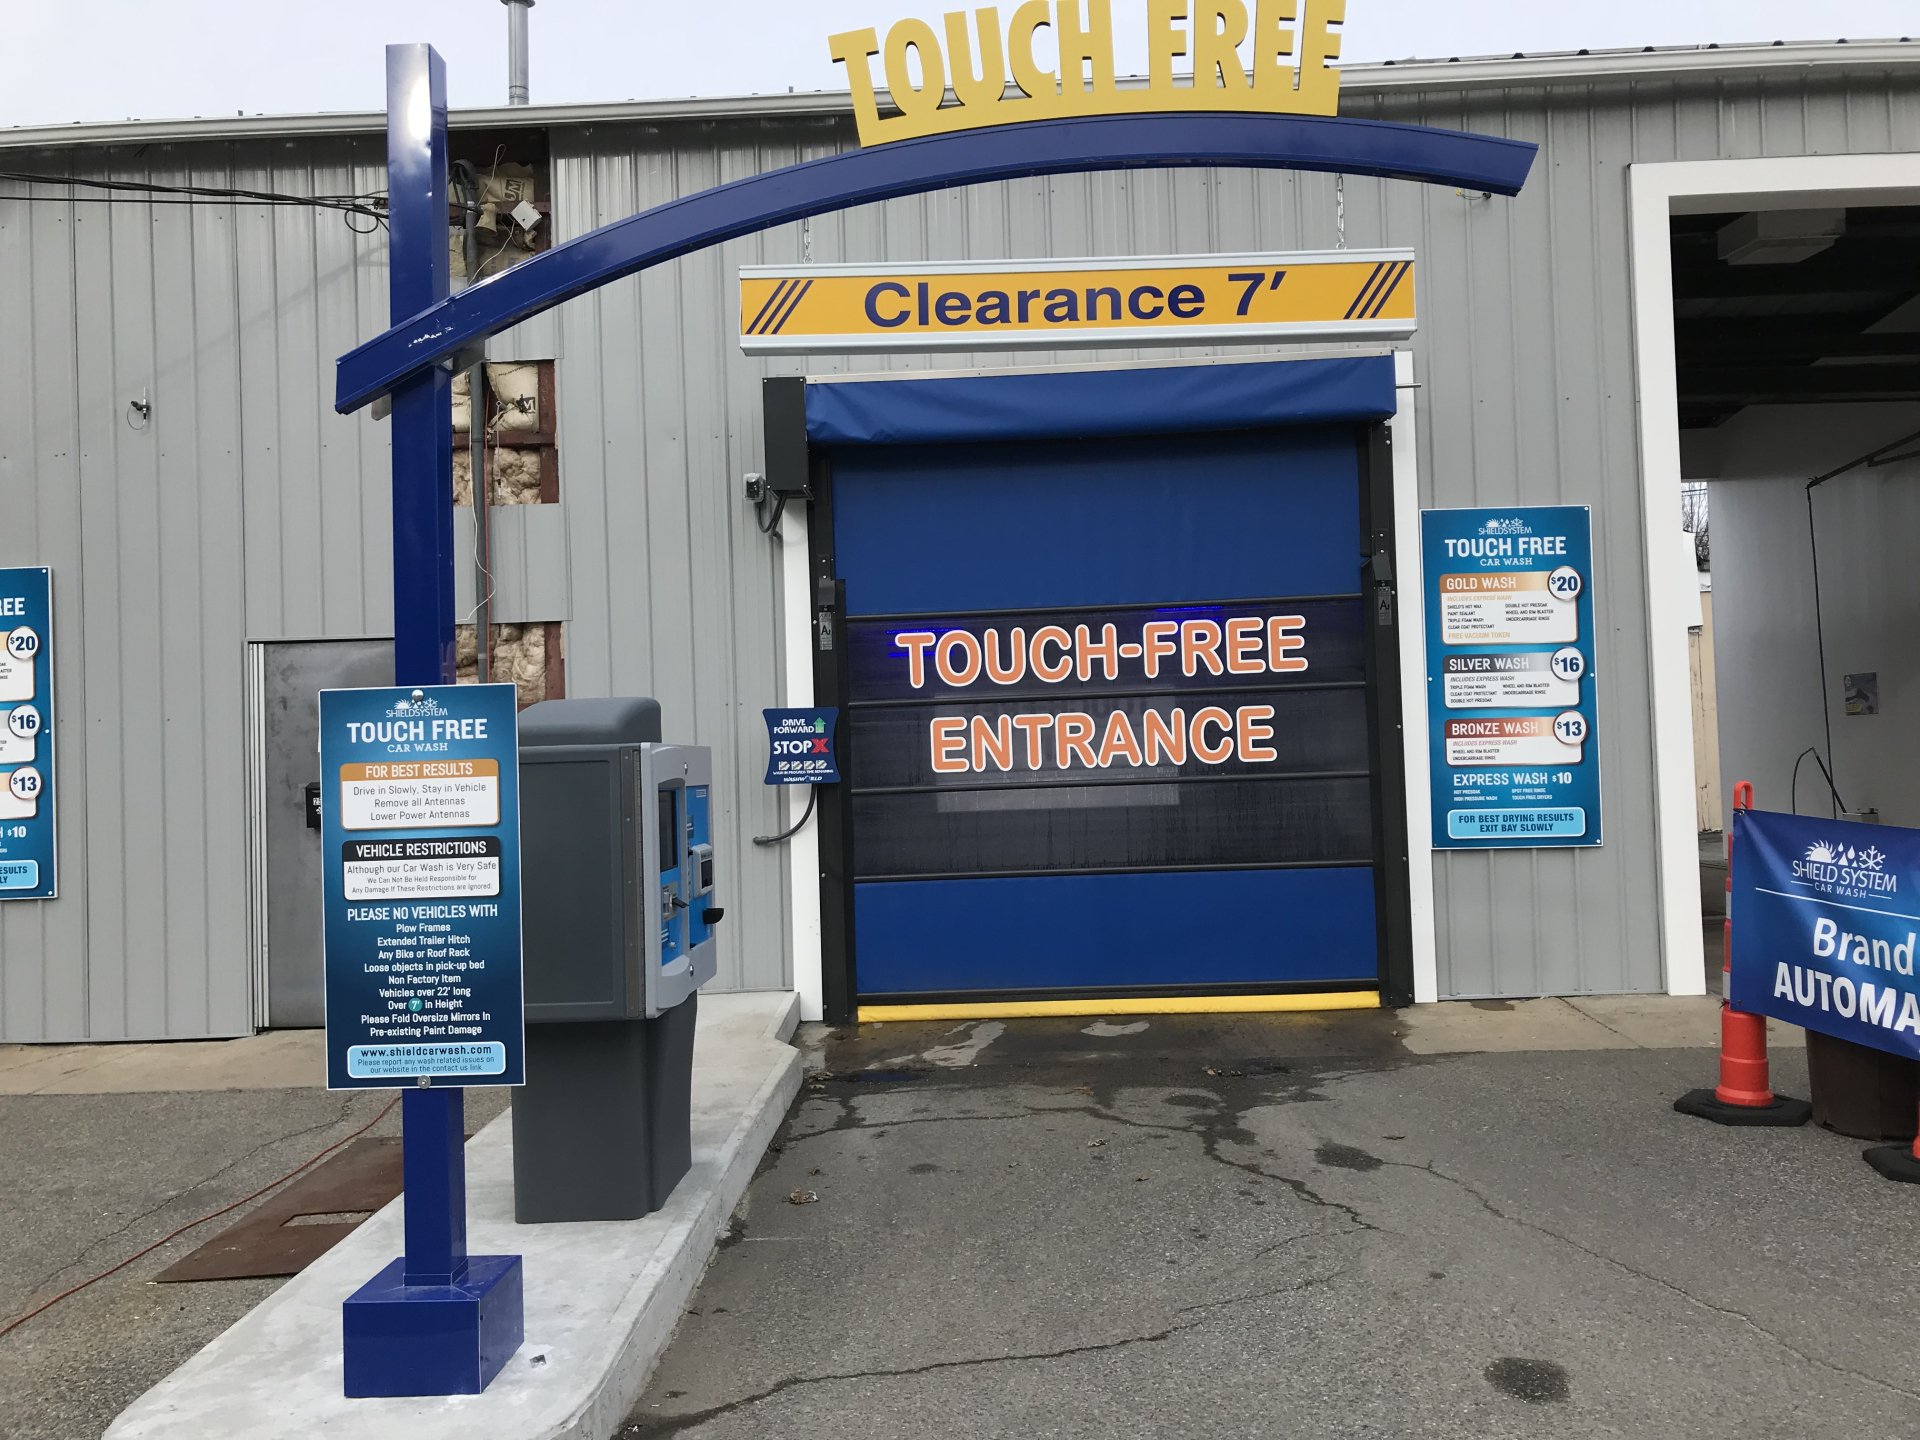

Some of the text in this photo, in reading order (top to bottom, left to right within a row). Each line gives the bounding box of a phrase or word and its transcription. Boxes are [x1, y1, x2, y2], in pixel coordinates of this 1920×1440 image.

[828, 0, 1344, 127] TOUCH FREE
[864, 271, 1286, 328] Clearance 7'
[1445, 536, 1566, 557] TOUCH FREE
[1480, 557, 1532, 566] CAR WASH
[1447, 576, 1578, 591] GOLD WASH $20
[0, 598, 25, 616] EE
[10, 636, 35, 650] $20
[895, 615, 1308, 689] TOUCH-FREE
[1450, 657, 1579, 673] SILVER WASH $16
[12, 714, 36, 730] $16
[347, 719, 488, 743] TOUCH FREE
[774, 726, 814, 734] FORWARD
[1452, 721, 1582, 737] BRONZE WASH $13
[930, 705, 1278, 773] ENTRANCE
[387, 743, 448, 752] CAR WASH
[366, 763, 472, 778] FOR BEST RESULTS
[13, 776, 37, 791] $13
[1454, 772, 1572, 786] EXPRESS WASH $10
[354, 786, 375, 796] Drive
[378, 786, 385, 794] in
[422, 784, 441, 795] Stay
[455, 784, 486, 792] Vehicle
[375, 799, 408, 807] Remove
[425, 798, 465, 806] Antennas
[371, 812, 396, 820] Lower
[400, 812, 426, 820] Power
[1459, 813, 1574, 823] FOR BEST DRYING RESULTS
[7, 826, 26, 837] $10
[1480, 824, 1499, 832] EXIT
[1520, 823, 1553, 831] SLOWLY
[356, 841, 486, 857] VEHICLE RESTRICTIONS
[348, 866, 384, 875] Although
[404, 864, 416, 872] Car
[420, 863, 443, 871] Wash
[456, 863, 474, 871] Very
[478, 861, 496, 870] Safe
[430, 875, 466, 883] Responsible
[1792, 860, 1897, 892] SHIELD SYSTEM
[1814, 883, 1866, 898] CAR WASH
[348, 904, 498, 921] PLEASE NO VEHICLES WITH
[396, 924, 451, 932] Plow Frames
[378, 936, 470, 946] Extended Trailer Hitch
[1813, 917, 1916, 976] Brand
[378, 950, 393, 960] Any
[396, 950, 414, 958] Bike
[428, 949, 447, 957] Roof
[449, 949, 470, 957] Rack
[364, 961, 484, 973] Loose objects in pick-up bed
[388, 974, 461, 985] Non Factory Item
[379, 988, 414, 997] Vehicles
[437, 987, 450, 996] 22'
[453, 987, 471, 996] long
[1773, 961, 1920, 1035] AUTOMA
[388, 1001, 406, 1009] Over
[425, 1000, 432, 1008] in
[435, 999, 463, 1009] Height
[362, 1015, 389, 1024] Please
[413, 1014, 448, 1022] Oversize
[451, 1013, 480, 1022] Mirrors
[483, 1012, 490, 1021] In
[370, 1026, 482, 1037] Pre-existing Paint Damage
[361, 1046, 492, 1057] www.shieldcarwash.com
[358, 1058, 380, 1066] Please
[382, 1058, 402, 1066] report
[383, 1065, 410, 1073] website
